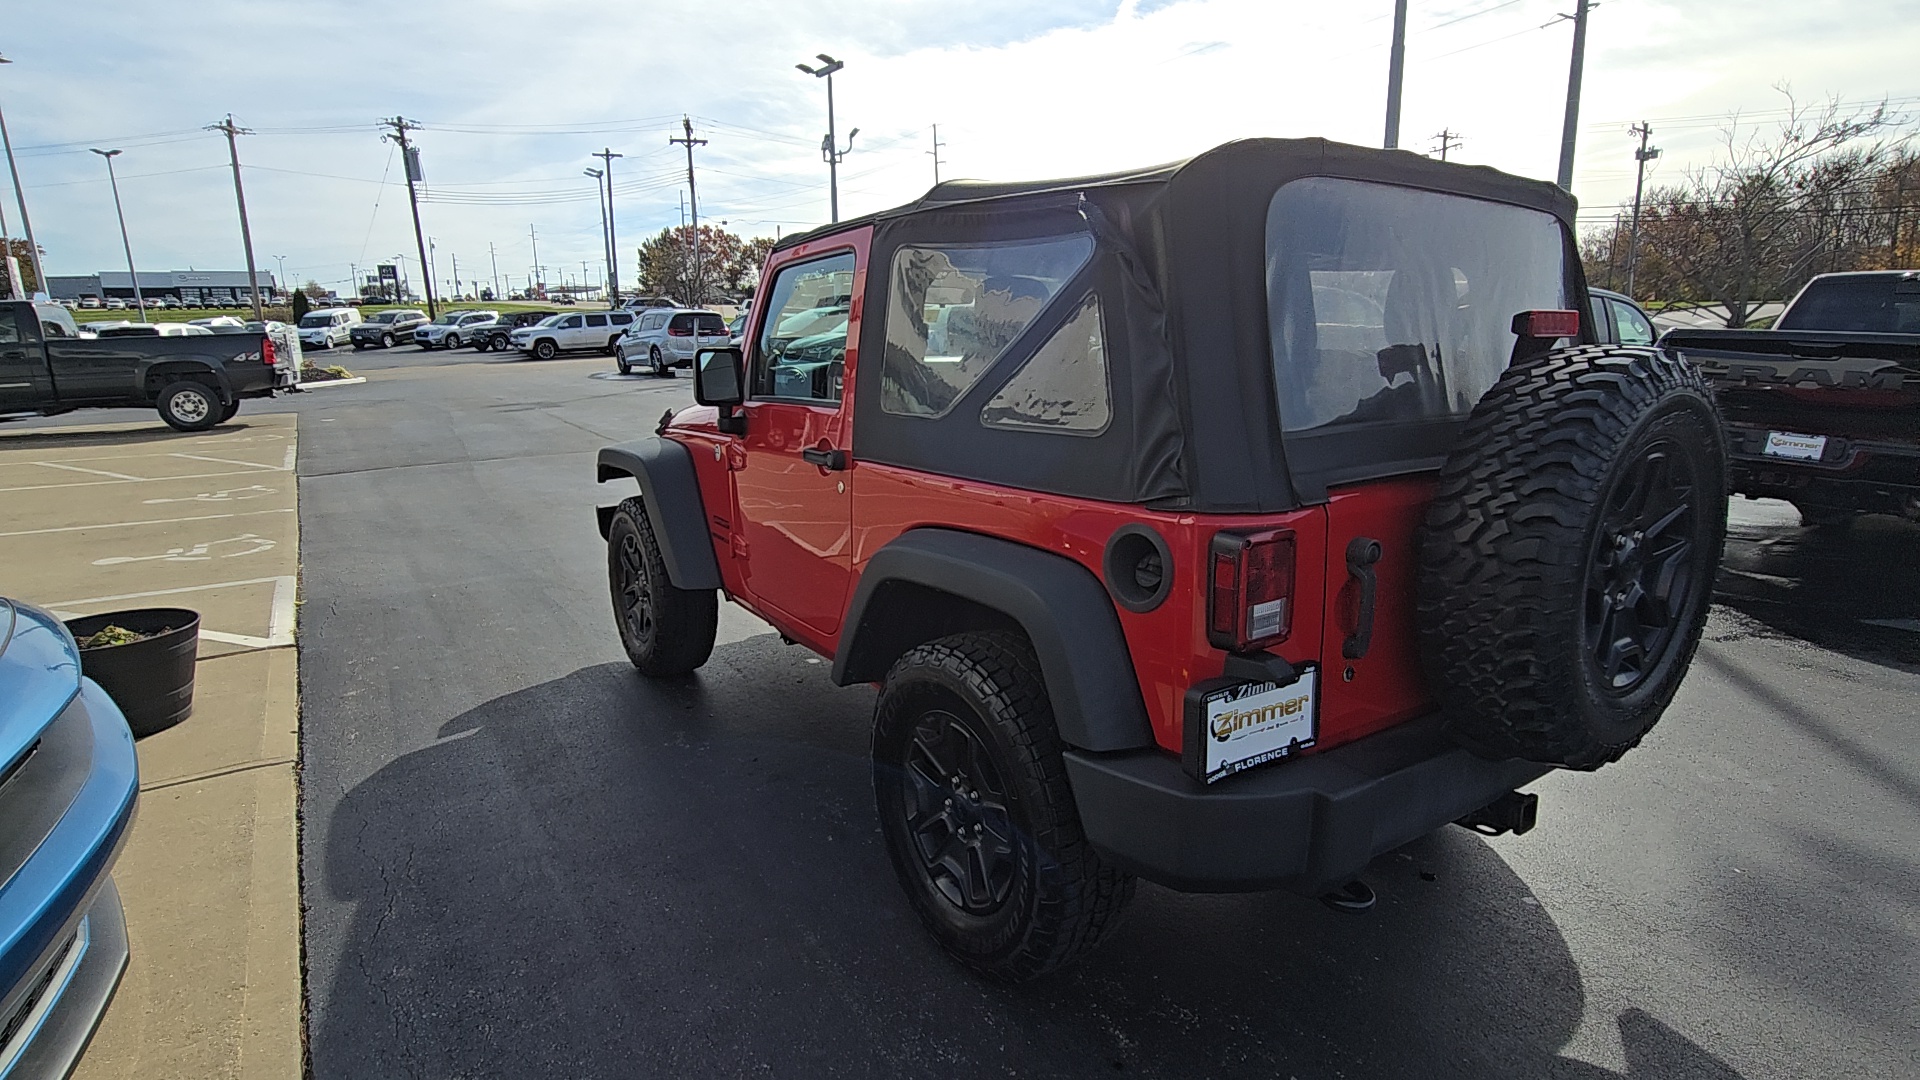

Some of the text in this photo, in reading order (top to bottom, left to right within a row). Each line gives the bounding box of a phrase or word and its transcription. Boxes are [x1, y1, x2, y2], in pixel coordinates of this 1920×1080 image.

[1727, 365, 1905, 389] RAM
[1774, 438, 1822, 449] Zimmer
[1237, 683, 1276, 700] Zimm
[1215, 694, 1309, 738] Zimmer
[1235, 748, 1288, 772] FLORENCE
